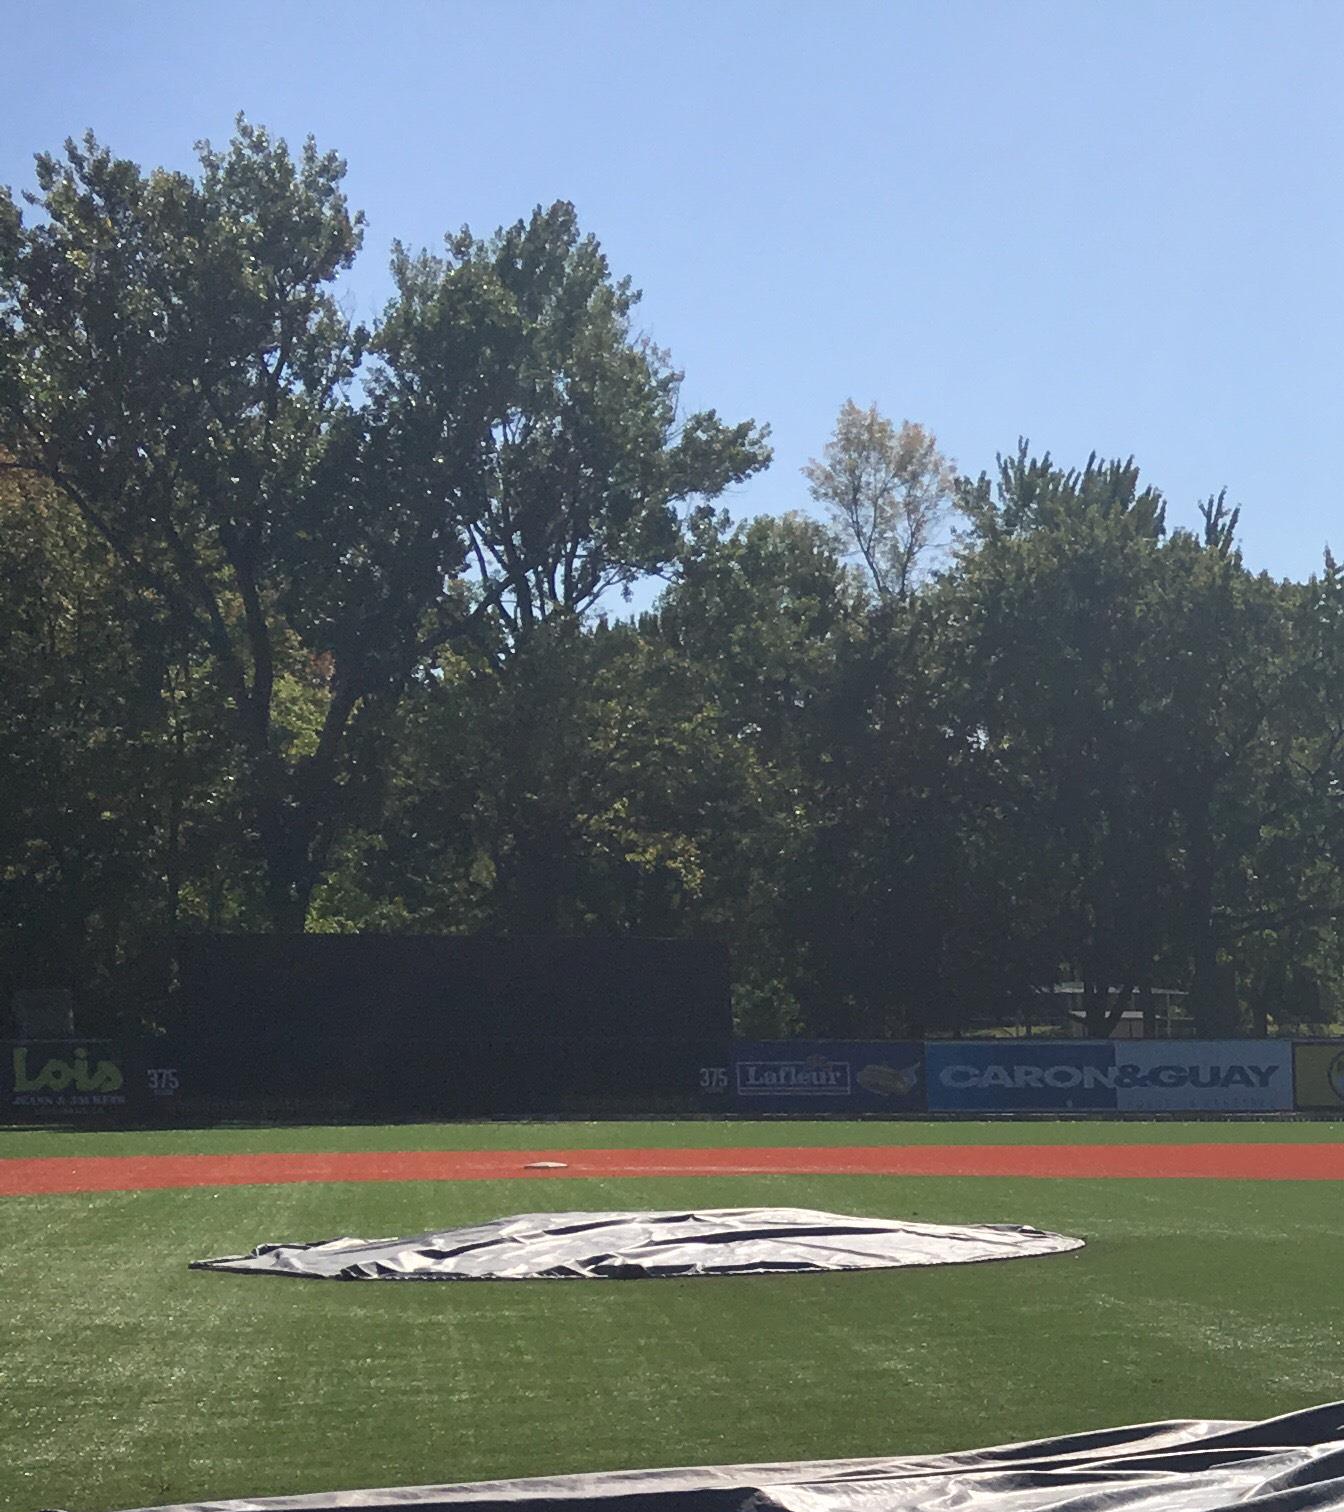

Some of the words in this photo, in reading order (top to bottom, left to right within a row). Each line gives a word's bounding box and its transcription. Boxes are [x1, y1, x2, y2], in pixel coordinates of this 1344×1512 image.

[13, 1048, 124, 1092] Lois
[147, 1069, 180, 1090] 375
[700, 1067, 728, 1088] 375
[745, 1066, 841, 1086] Lafleur
